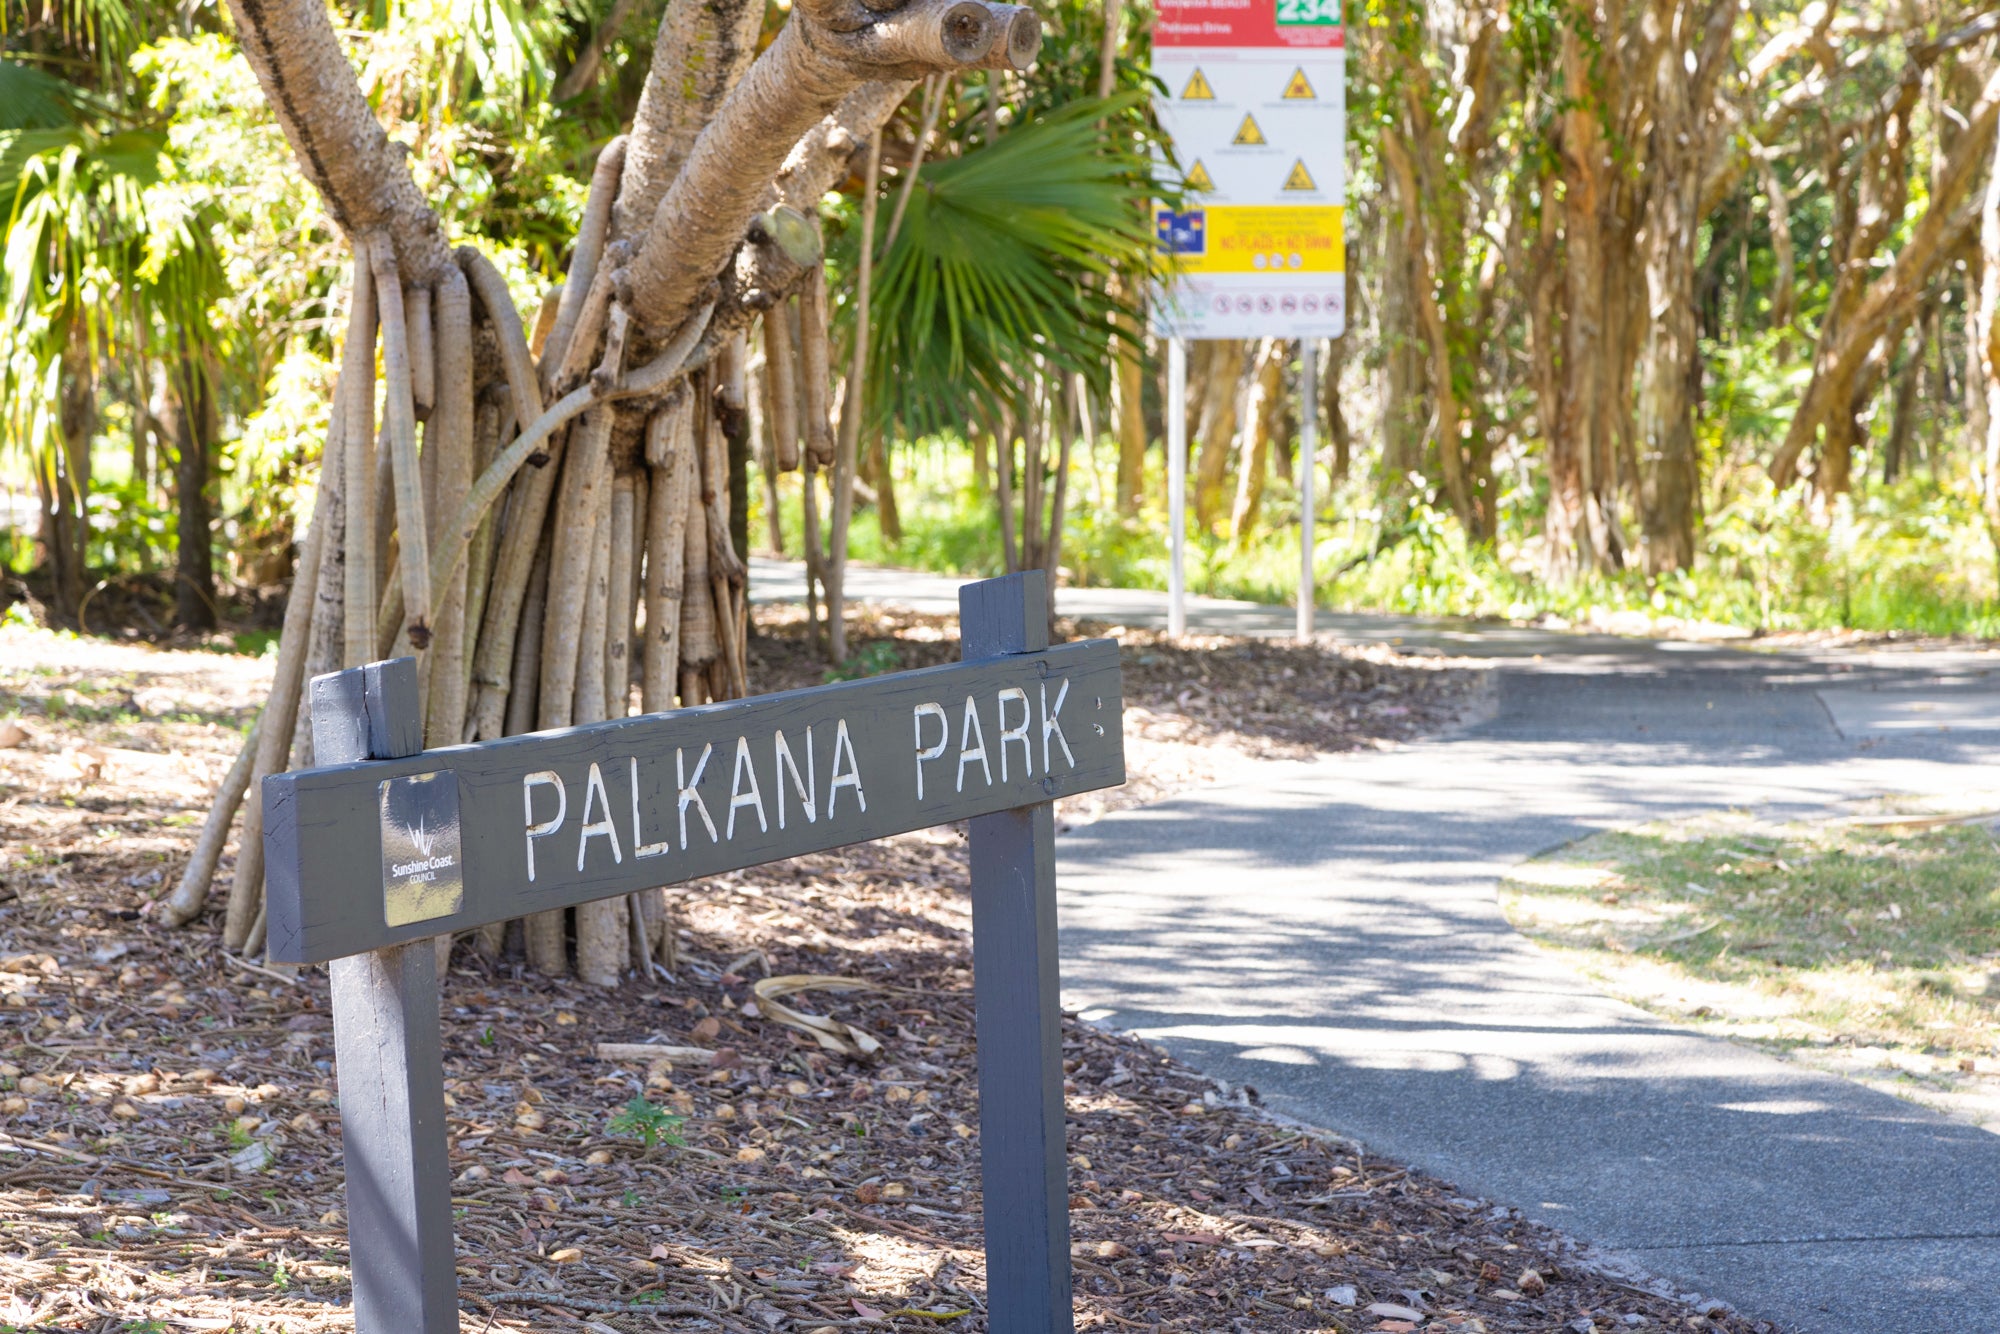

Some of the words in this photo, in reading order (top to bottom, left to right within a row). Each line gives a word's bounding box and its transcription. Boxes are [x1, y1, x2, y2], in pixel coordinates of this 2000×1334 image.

[1278, 0, 1342, 21] 234
[523, 718, 867, 882] PALKANA
[914, 678, 1076, 801] PARK
[392, 861, 429, 878] Sunshine
[429, 855, 453, 870] Coast
[410, 871, 436, 885] COUNCIL
